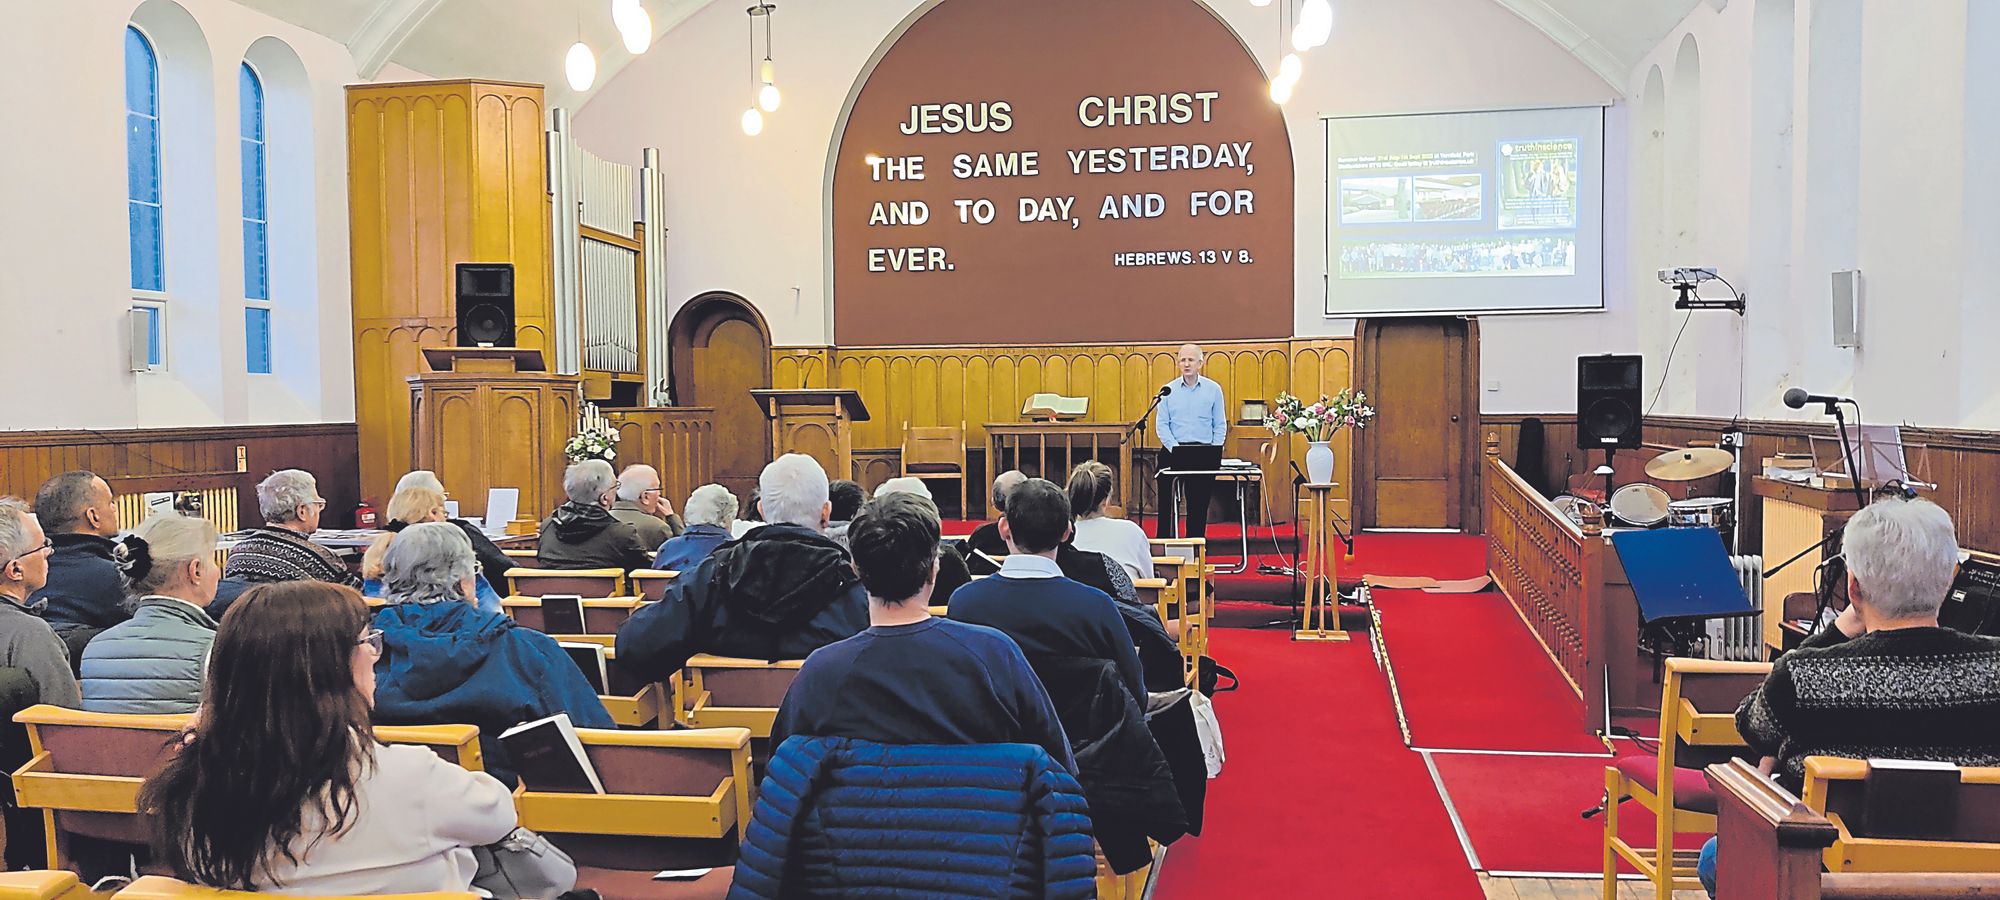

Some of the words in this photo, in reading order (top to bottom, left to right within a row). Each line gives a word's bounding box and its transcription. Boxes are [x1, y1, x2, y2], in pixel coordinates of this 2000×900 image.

[900, 101, 1012, 135] JESUS
[1078, 91, 1219, 127] CHRIST
[866, 155, 925, 181] THE
[952, 151, 1039, 179] SAME
[1067, 141, 1254, 176] YESTERDAY,
[869, 201, 929, 226] AND
[953, 199, 995, 224] TO
[1019, 196, 1079, 229] DAY,
[1099, 193, 1165, 219] AND
[1190, 189, 1254, 216] FOR
[868, 247, 954, 272] EVER.
[1198, 250, 1217, 264] 13
[1221, 250, 1233, 264] V
[1238, 249, 1254, 264] 8.
